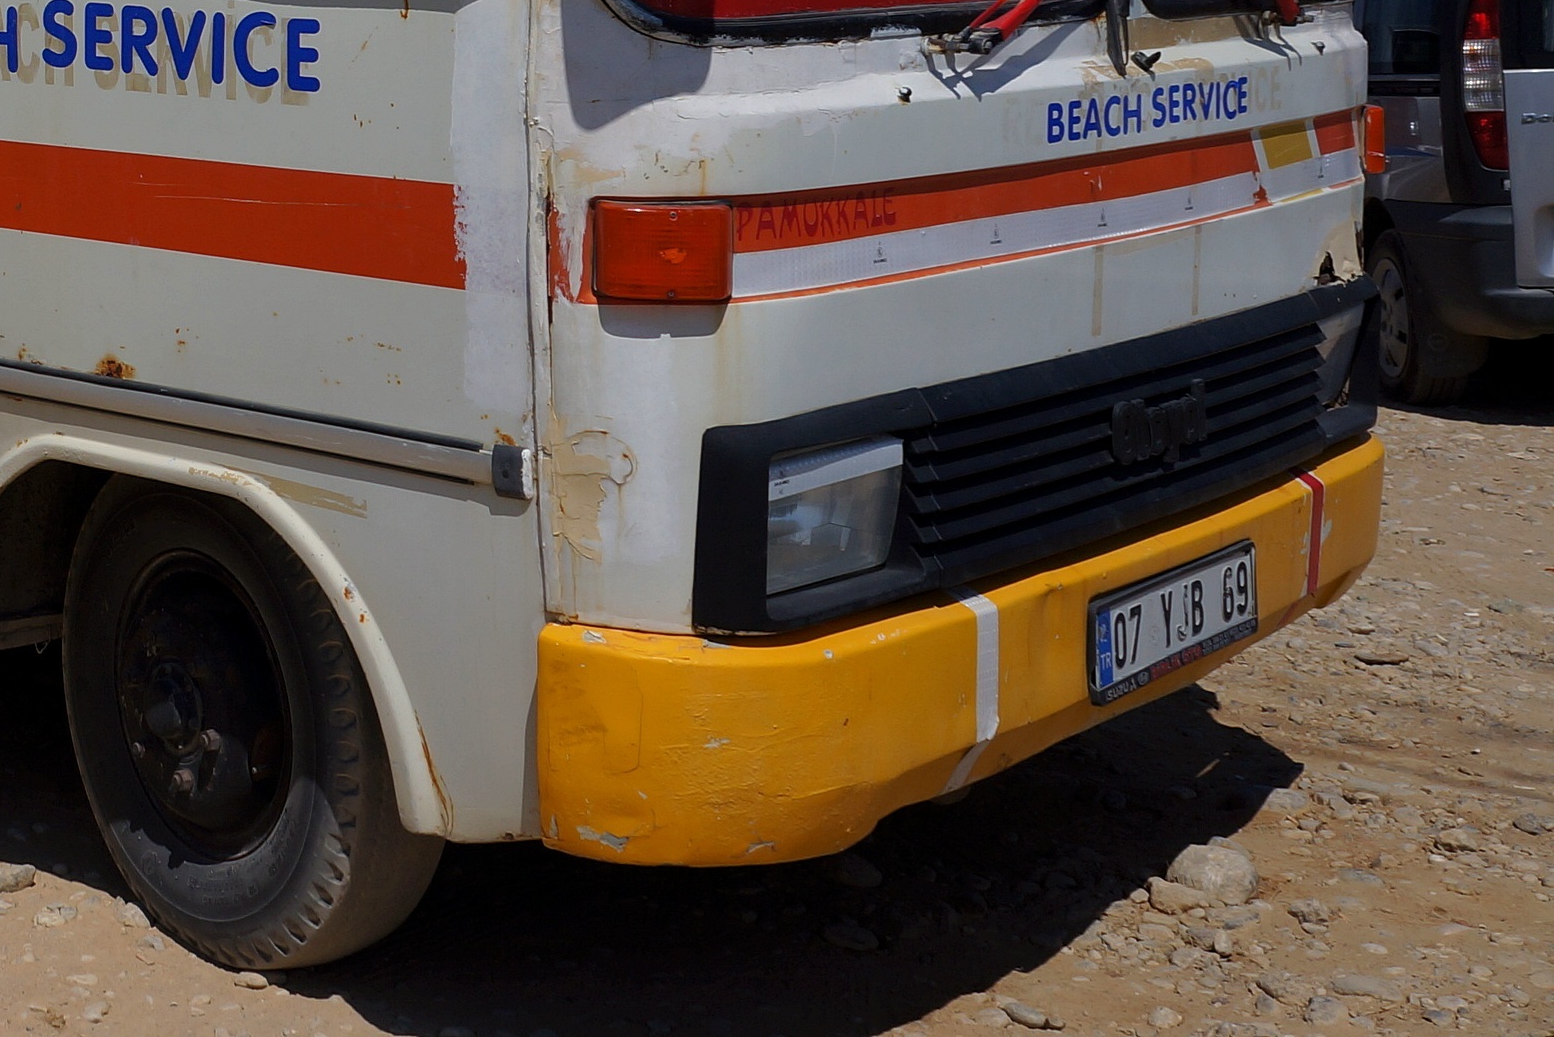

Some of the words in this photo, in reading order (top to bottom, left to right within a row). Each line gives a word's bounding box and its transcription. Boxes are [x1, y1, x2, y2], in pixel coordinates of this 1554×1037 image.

[1047, 95, 1143, 145] BEACH
[1152, 76, 1249, 129] SERVICE
[1114, 605, 1142, 668] 07
[1223, 561, 1249, 623] 69
[1100, 652, 1113, 671] TR
